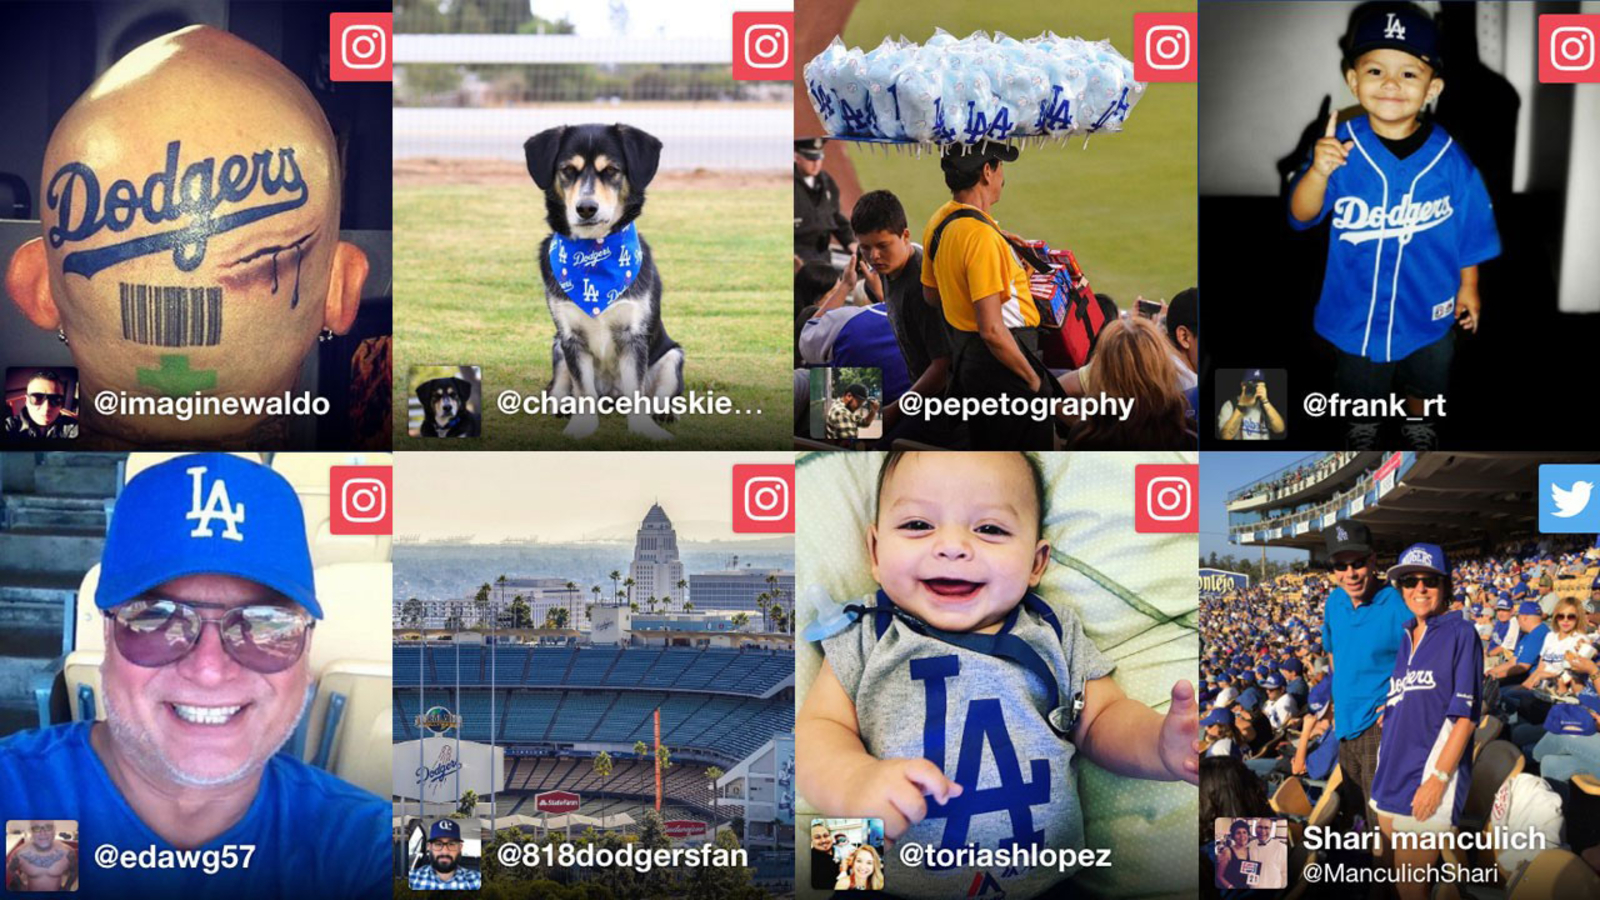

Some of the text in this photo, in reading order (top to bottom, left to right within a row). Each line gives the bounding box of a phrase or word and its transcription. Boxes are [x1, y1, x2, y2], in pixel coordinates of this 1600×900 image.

[1384, 13, 1406, 40] LA
[48, 140, 309, 272] Dodgers
[1333, 193, 1454, 245] Dodgers
[573, 246, 612, 267] Dodgers
[618, 244, 631, 267] LA
[583, 278, 599, 302] LA
[185, 466, 245, 542] LA
[910, 654, 1051, 871] LA
